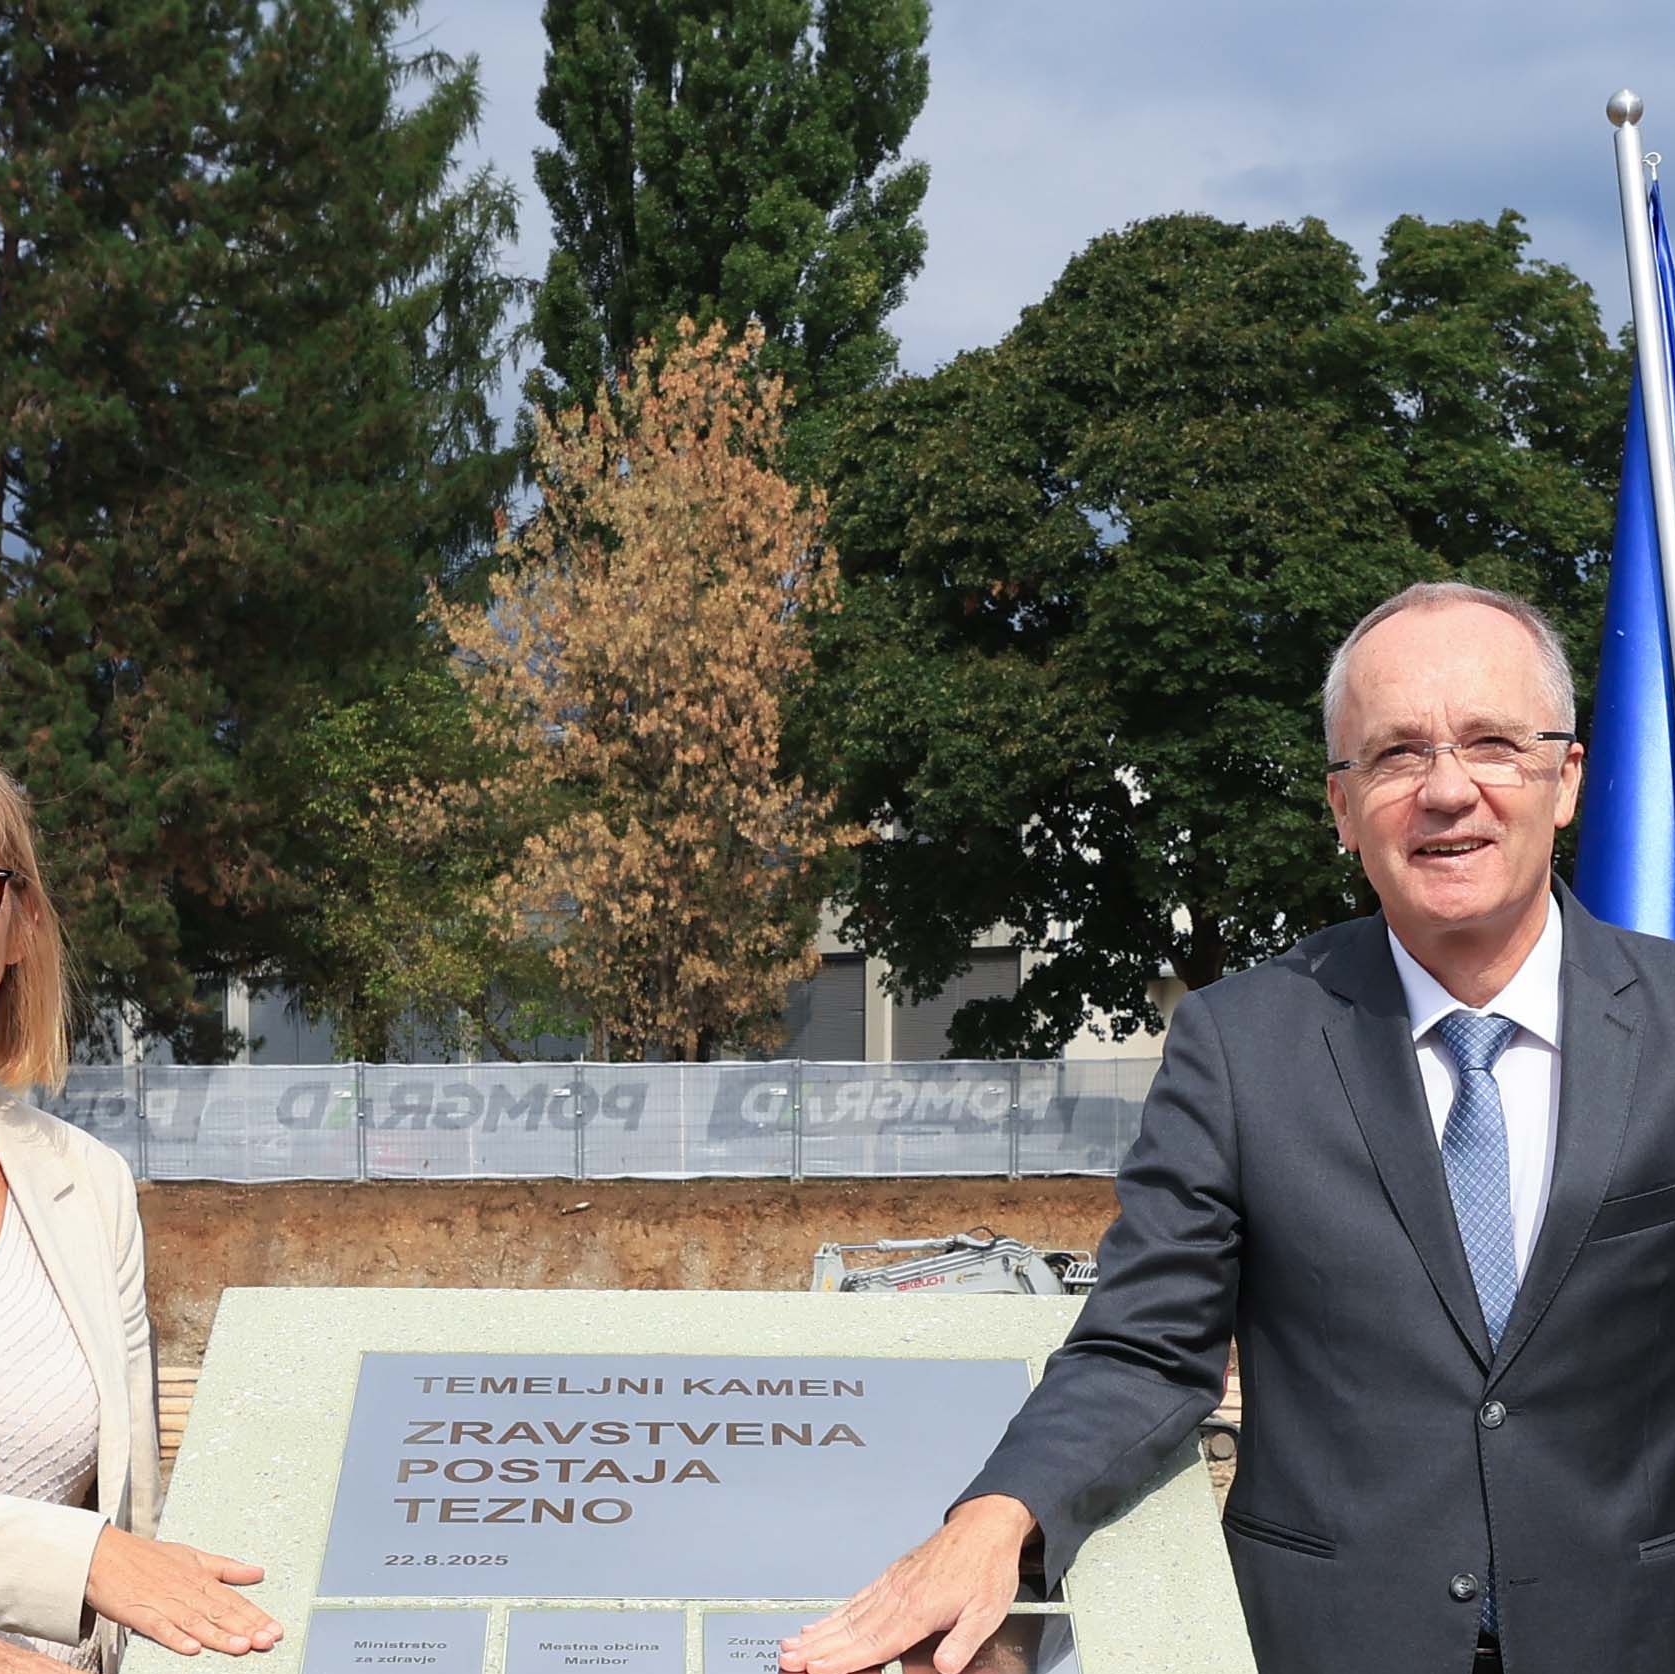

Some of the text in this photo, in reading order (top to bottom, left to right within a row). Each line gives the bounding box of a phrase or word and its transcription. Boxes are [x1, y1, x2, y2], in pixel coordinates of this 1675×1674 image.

[413, 1376, 865, 1397] TEMELJNI KAMEN
[402, 1421, 867, 1447] ZRAVSTVENA
[396, 1458, 721, 1485] POSTAJA
[393, 1497, 634, 1525] TEZNO
[383, 1554, 509, 1567] 22.8.2025
[353, 1640, 448, 1650] Ministrstvo
[538, 1641, 660, 1652] Mestna občina
[727, 1637, 782, 1646] Zdravs
[354, 1654, 437, 1666] za zdravje
[729, 1650, 750, 1659] dr.
[564, 1656, 630, 1666] Maribor
